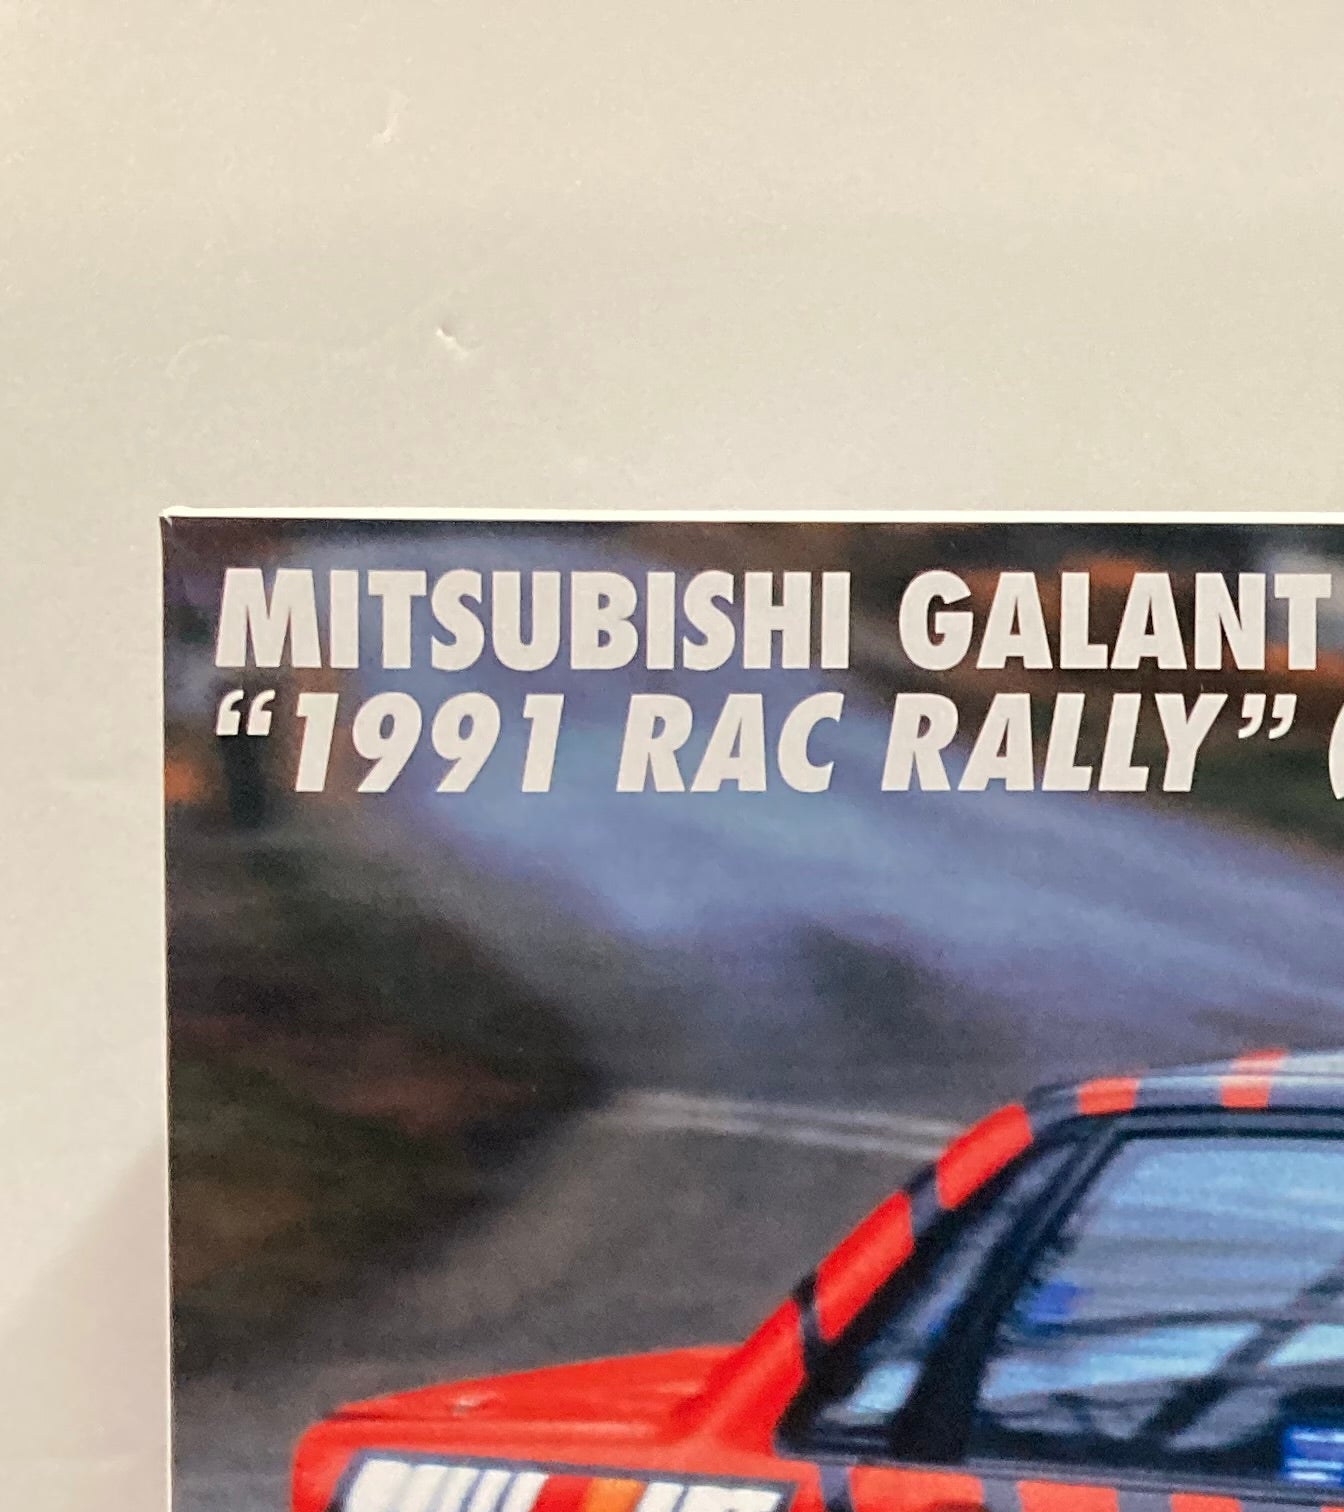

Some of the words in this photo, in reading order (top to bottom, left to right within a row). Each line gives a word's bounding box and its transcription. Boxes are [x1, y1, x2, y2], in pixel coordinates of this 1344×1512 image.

[214, 568, 853, 671] MITSUBISHI
[898, 570, 1332, 671] GALANT
[616, 692, 844, 793] RAC
